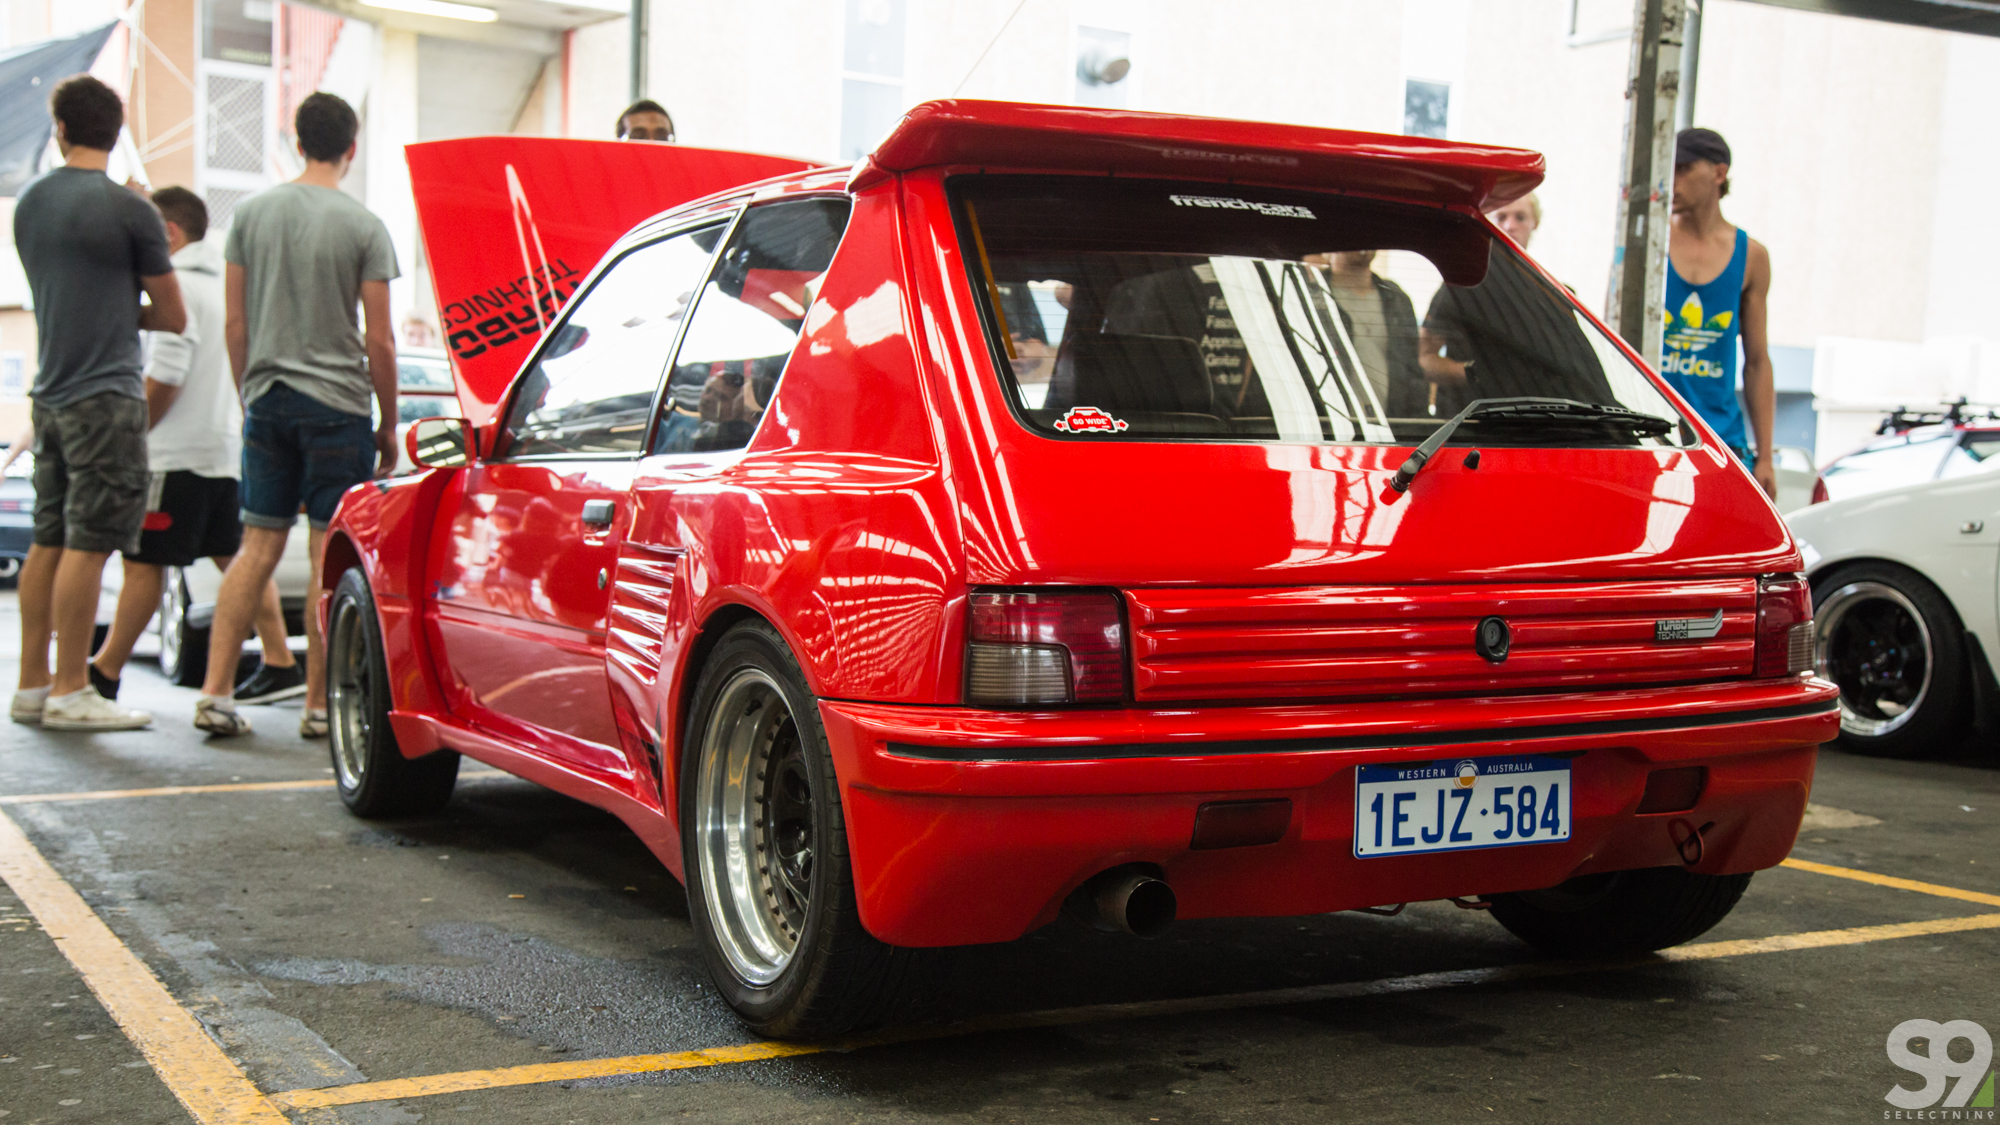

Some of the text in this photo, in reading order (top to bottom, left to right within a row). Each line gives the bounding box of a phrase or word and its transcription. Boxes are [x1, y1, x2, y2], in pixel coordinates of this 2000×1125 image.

[1169, 195, 1312, 216] frenchcars
[448, 280, 582, 359] URBO
[1660, 351, 1724, 378] didas
[1657, 619, 1688, 631] TURBO
[1657, 630, 1688, 640] TECHNICS
[1398, 762, 1534, 780] WESTERN AUSTRALIA
